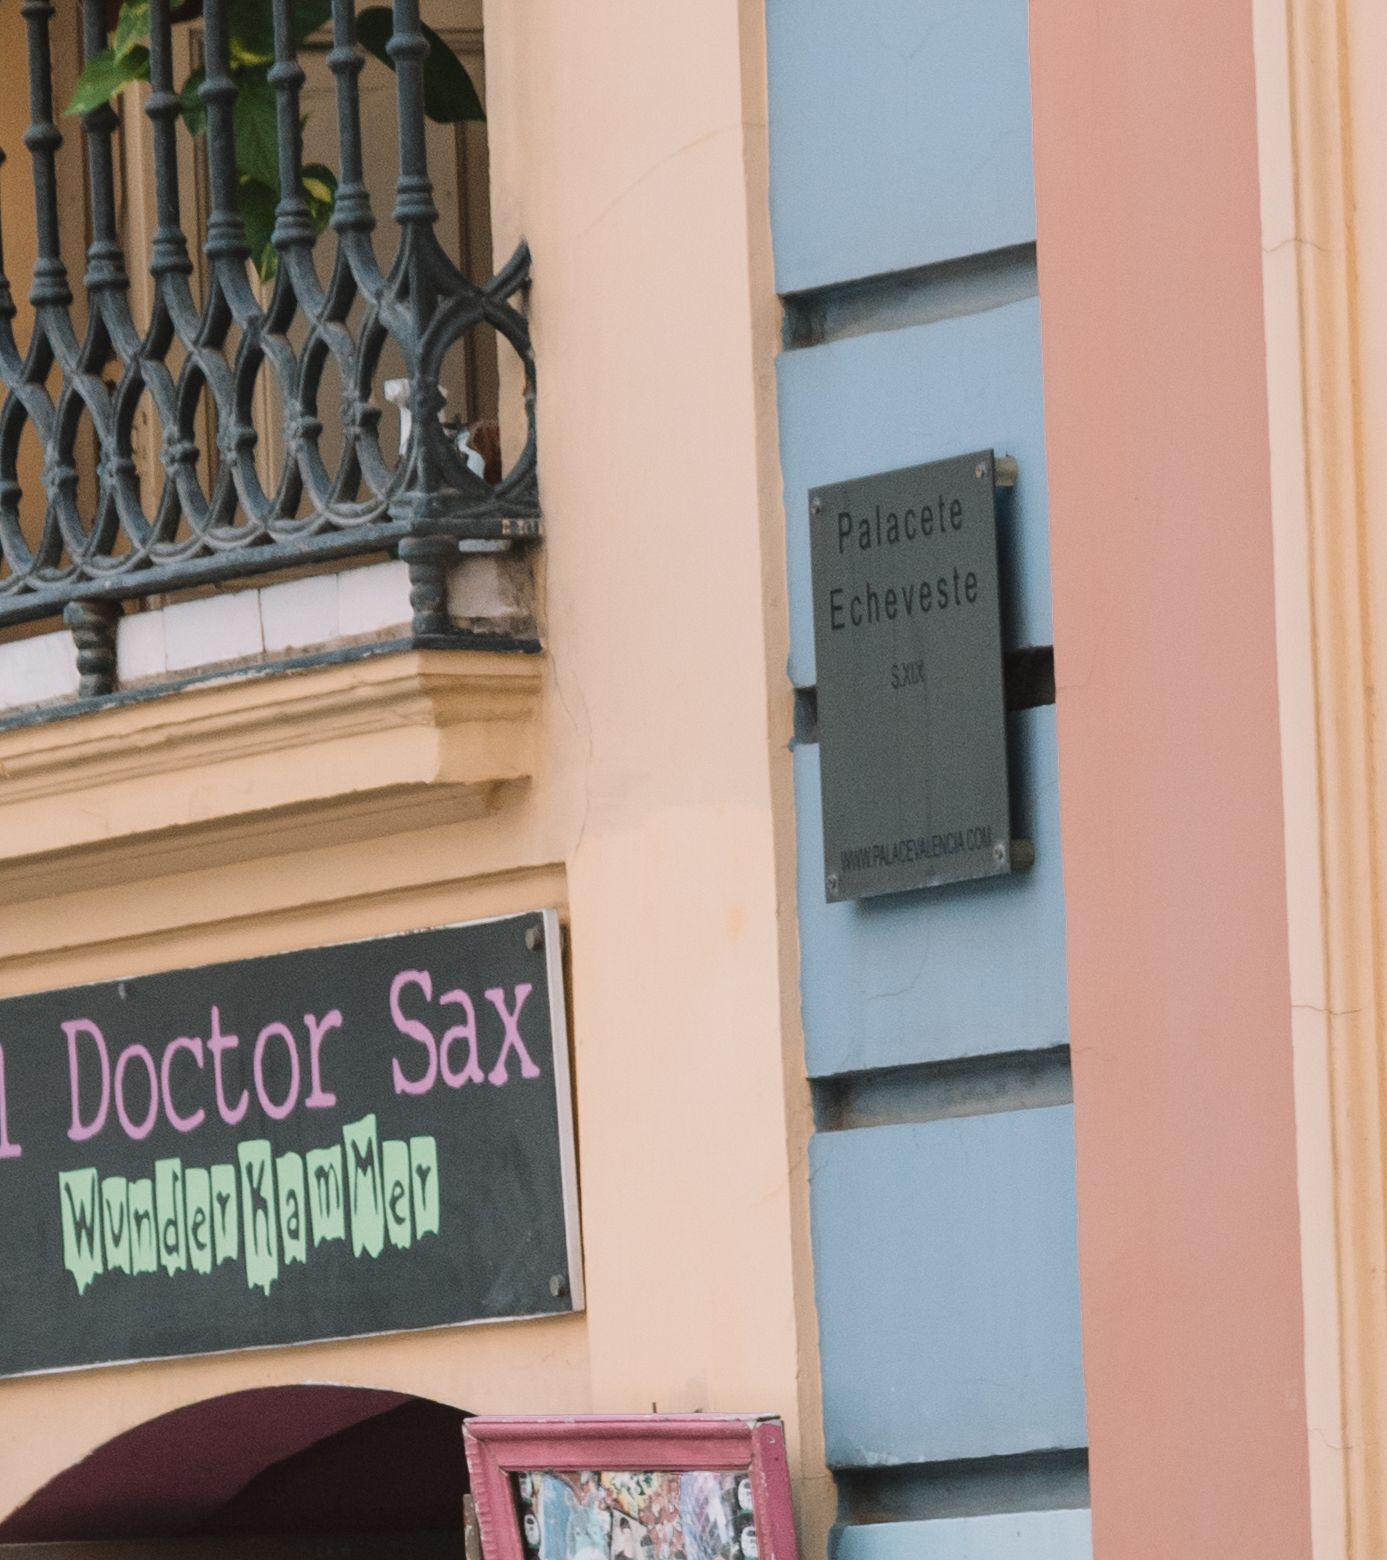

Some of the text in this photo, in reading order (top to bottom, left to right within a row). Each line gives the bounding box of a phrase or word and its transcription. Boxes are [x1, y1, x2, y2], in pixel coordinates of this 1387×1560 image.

[838, 495, 963, 553] Palacete
[829, 567, 978, 630] Echeveste
[60, 1004, 343, 1142] Doctor
[389, 969, 540, 1095] Sax
